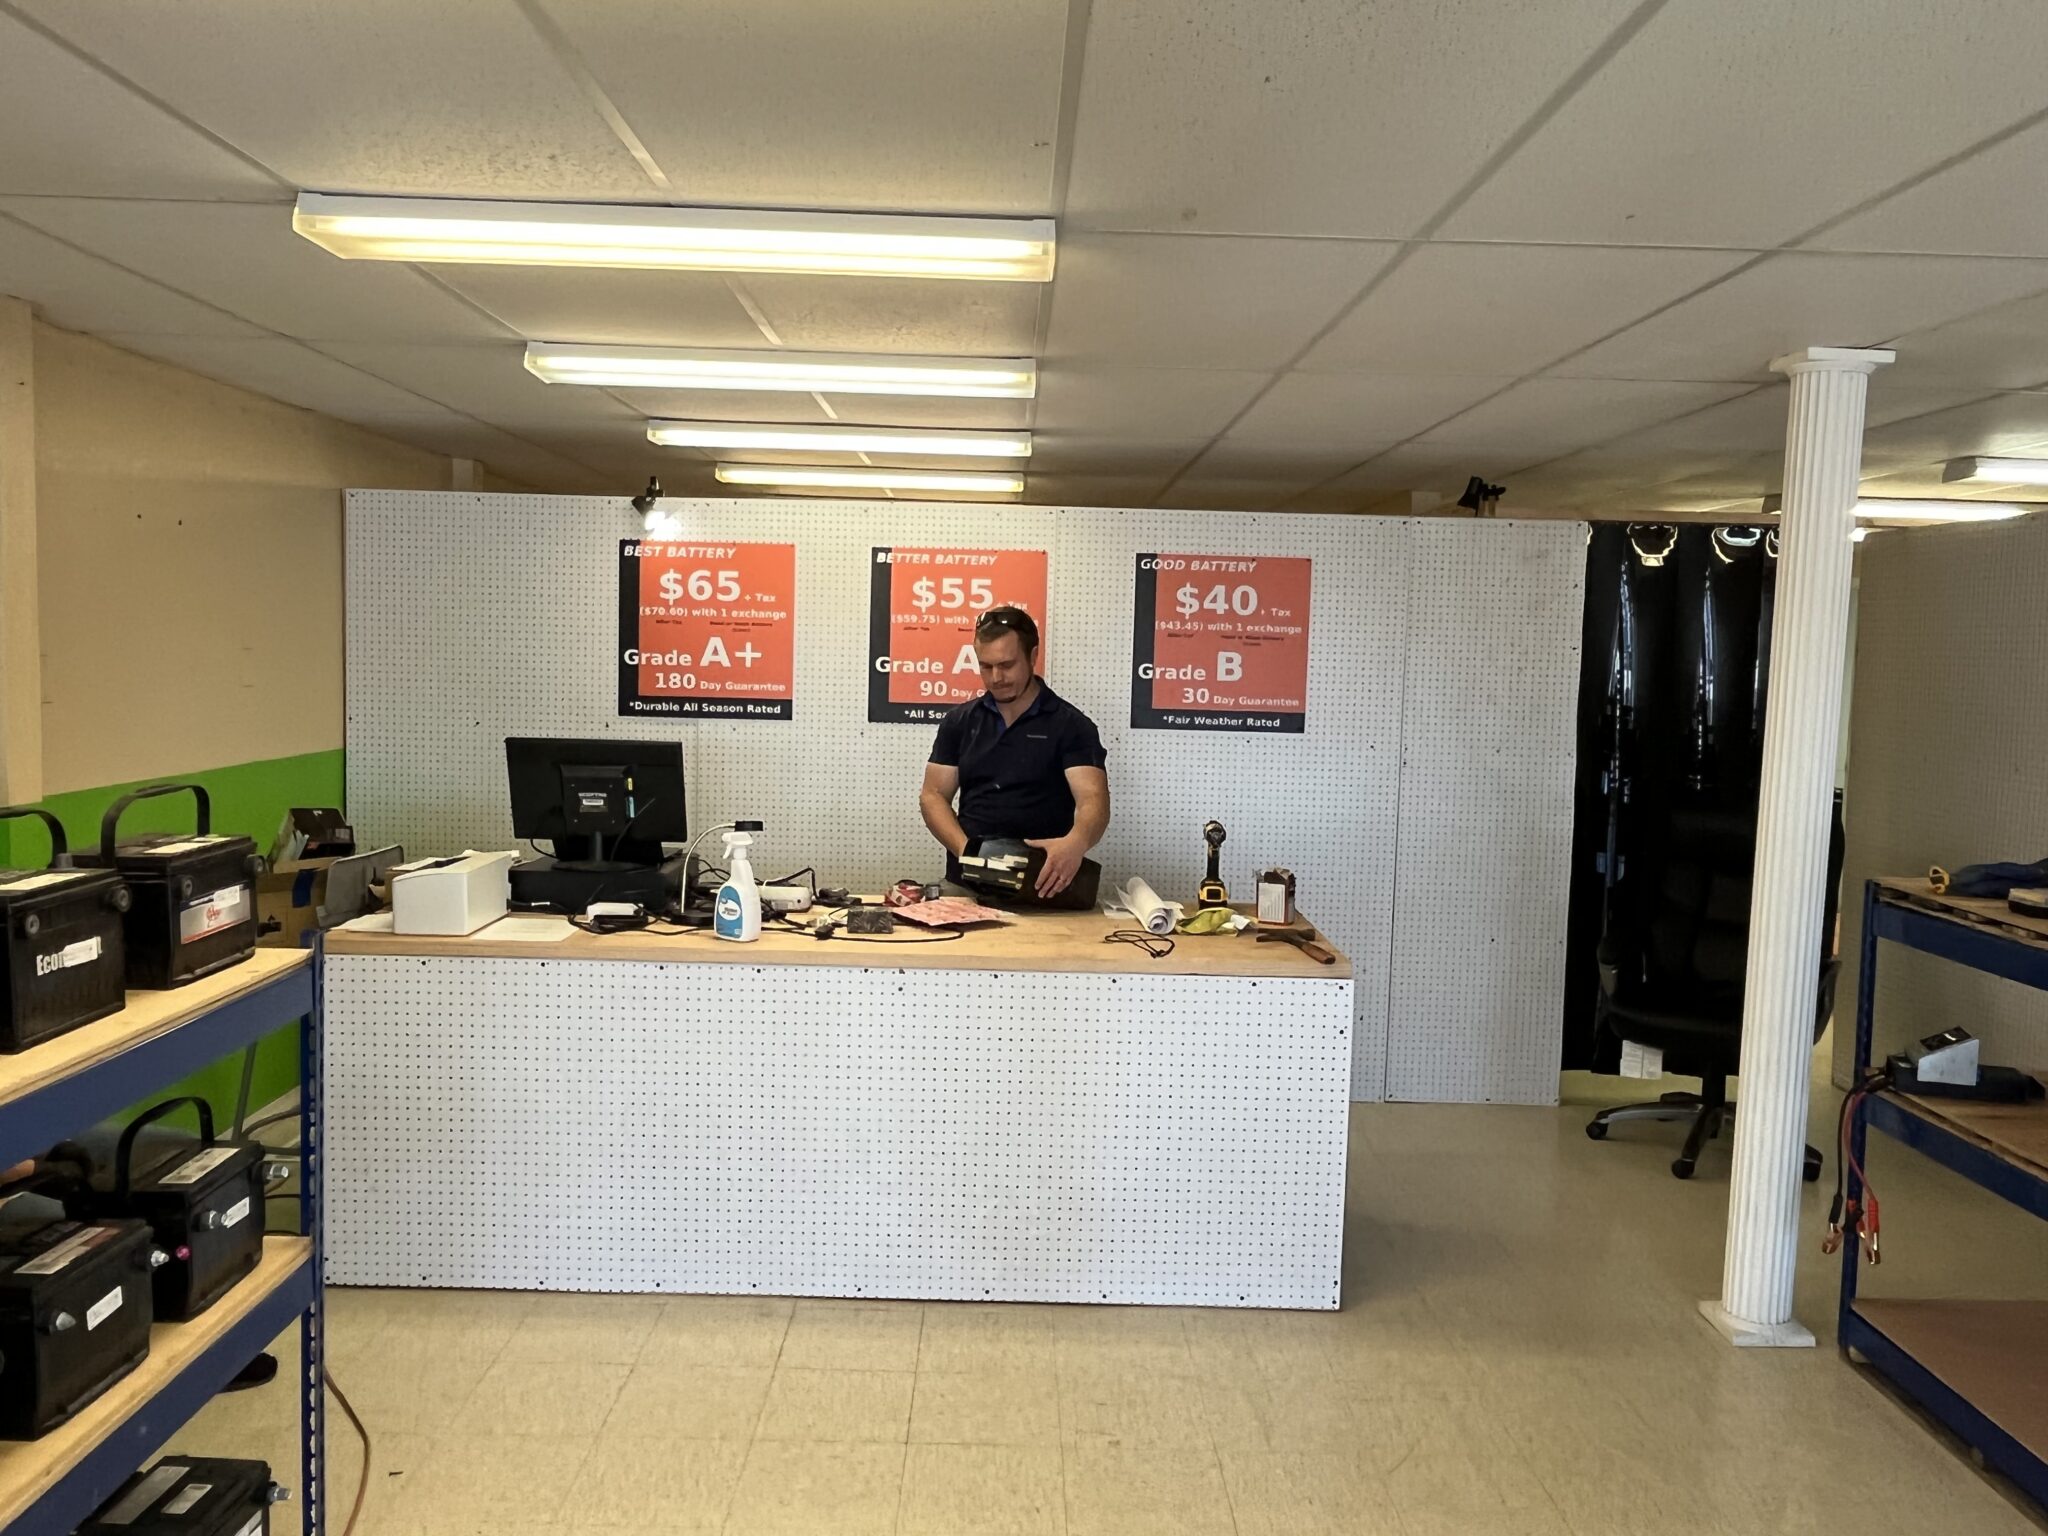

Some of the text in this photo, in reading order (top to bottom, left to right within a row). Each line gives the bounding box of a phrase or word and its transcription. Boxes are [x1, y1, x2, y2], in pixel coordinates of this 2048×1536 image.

[624, 545, 736, 559] BEST BATTERY
[876, 552, 998, 566] BETTER BATTERY
[1140, 558, 1257, 573] GOOD BATTERY
[659, 568, 741, 606] $65
[755, 593, 776, 602] Tax
[912, 576, 993, 613] $55
[1176, 582, 1258, 619] $40
[1270, 608, 1291, 617] Tax
[692, 608, 717, 617] with
[721, 608, 727, 617] 1
[731, 609, 787, 620] exchange
[944, 615, 969, 625] with
[1207, 622, 1232, 631] with
[1236, 623, 1243, 632] 1
[1246, 623, 1302, 635] exchange
[624, 649, 692, 666] Grade
[875, 656, 944, 674] Grade
[1138, 651, 1243, 682] Grade B
[655, 672, 786, 692] 180 Day Guarantee
[920, 680, 947, 697] 90
[951, 688, 973, 699] Day
[1181, 687, 1299, 707] 30 Day Guarantee
[683, 703, 698, 712] All
[702, 703, 743, 713] Season
[747, 705, 781, 714] Rated
[1194, 716, 1243, 726] Weather
[1247, 717, 1280, 728] Rated
